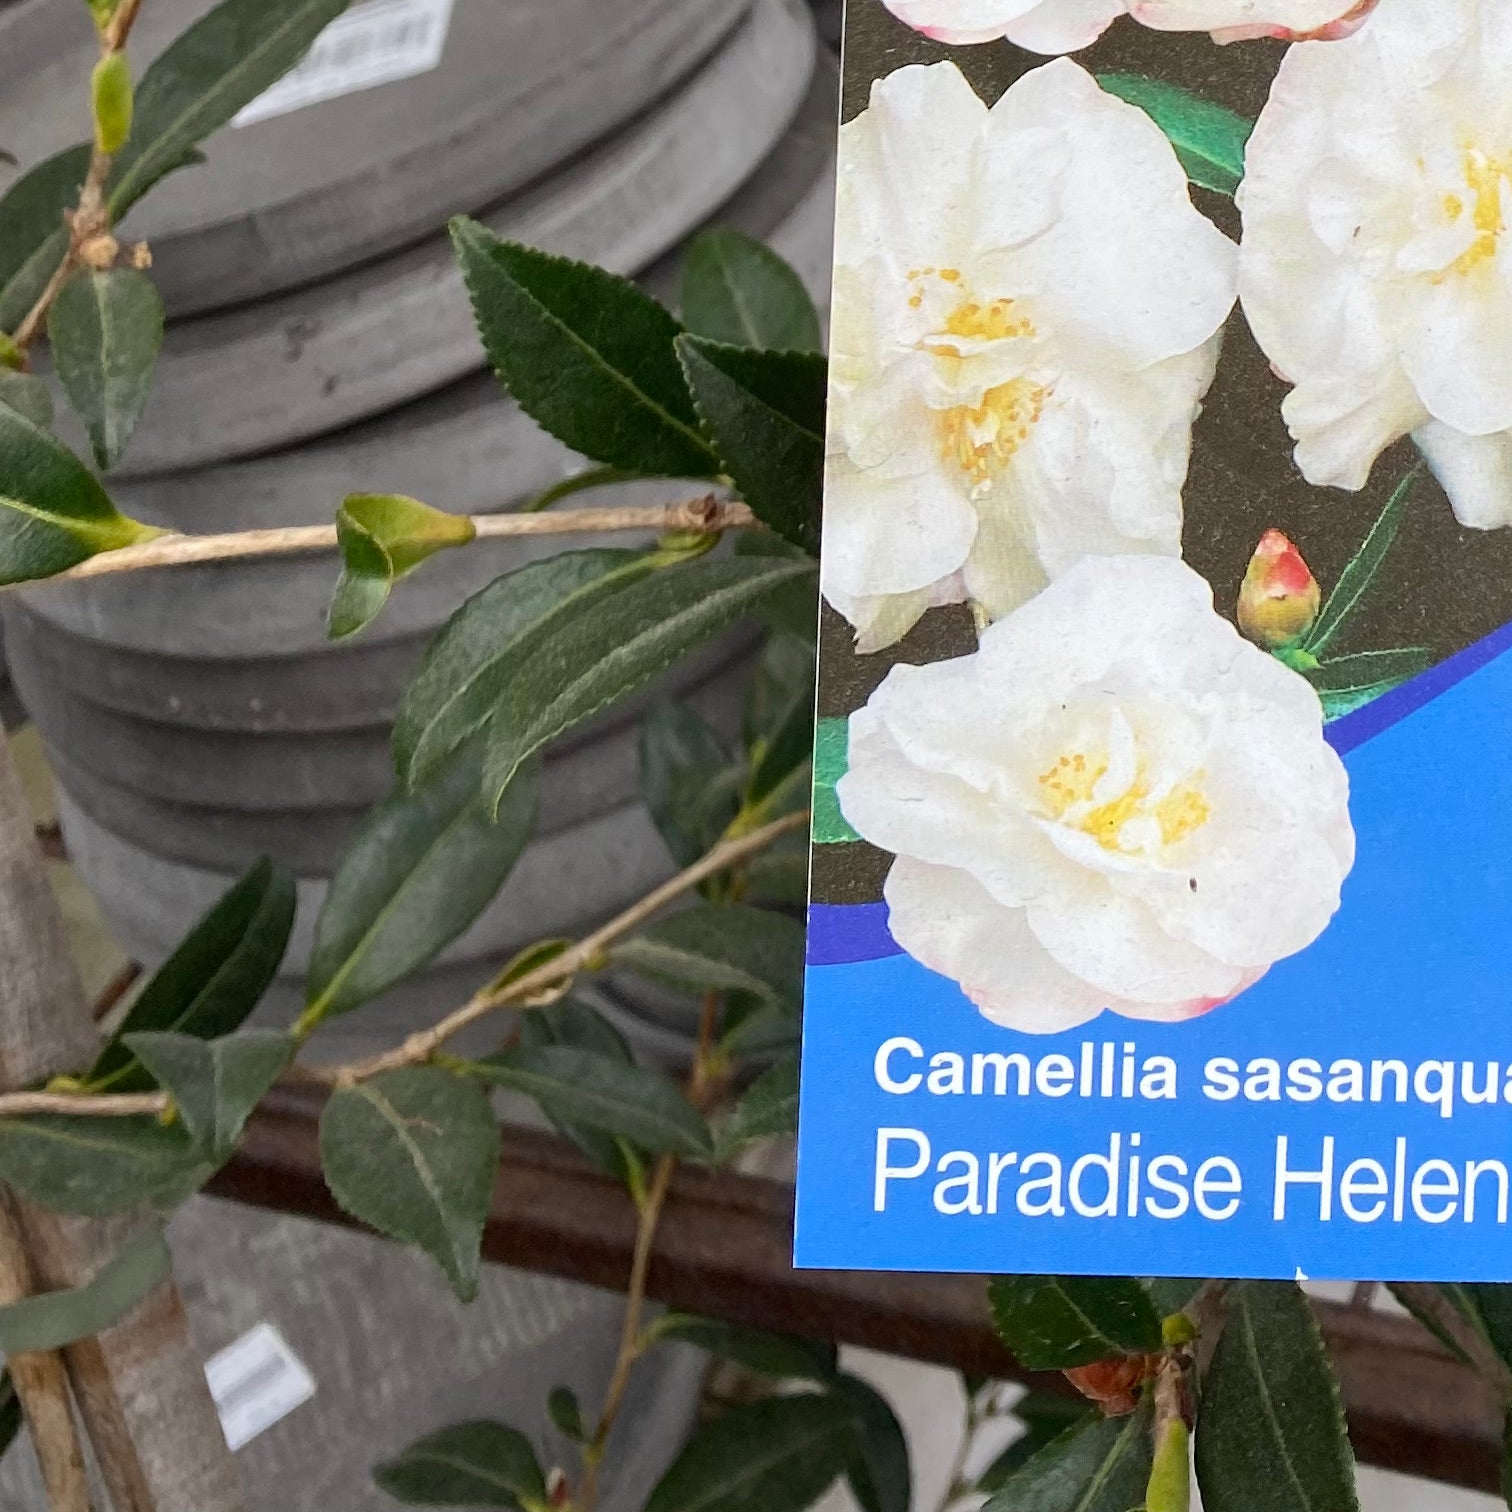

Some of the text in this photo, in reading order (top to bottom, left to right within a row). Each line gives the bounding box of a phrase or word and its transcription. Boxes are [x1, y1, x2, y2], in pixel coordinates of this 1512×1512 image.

[873, 1036, 1178, 1100] Camellia
[873, 1127, 1510, 1224] Paradise Helen
